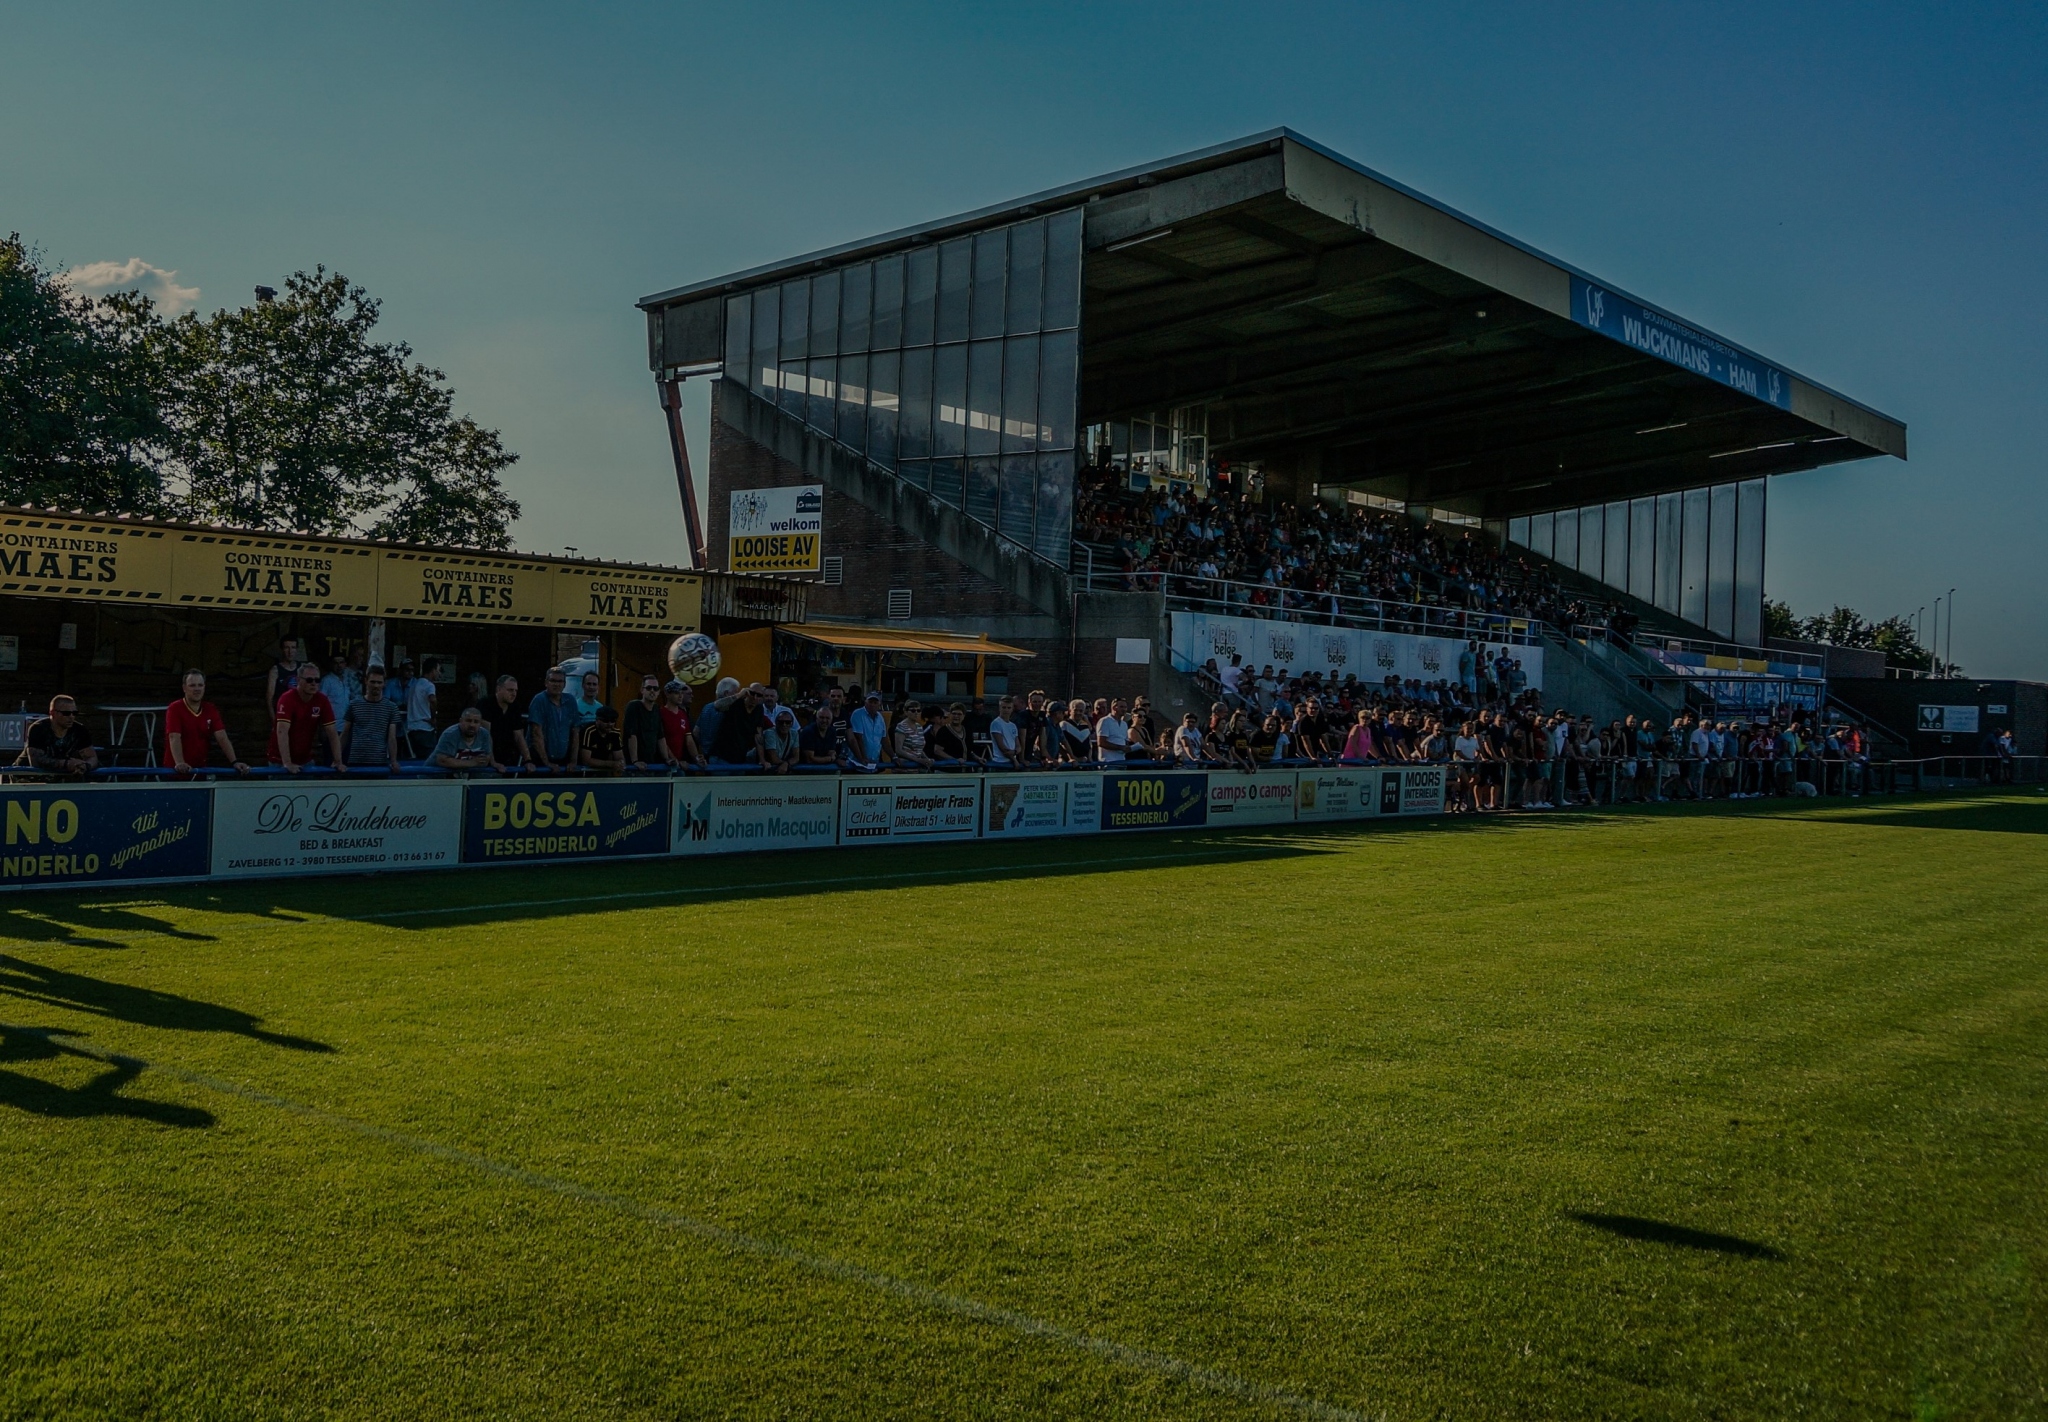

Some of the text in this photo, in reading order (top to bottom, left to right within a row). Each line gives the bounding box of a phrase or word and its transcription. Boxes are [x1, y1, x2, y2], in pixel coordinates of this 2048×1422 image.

[1622, 314, 1711, 374] WIJCKMANS
[1729, 362, 1757, 396] HAM
[770, 518, 820, 531] welkom
[0, 533, 118, 554] ONTAINERS
[735, 535, 814, 557] LOOISE AV
[0, 549, 117, 583] MAES
[225, 552, 332, 571] CONTAINERS
[224, 567, 331, 597] MAES
[422, 568, 514, 585] CONTAINERS
[422, 581, 513, 609] MAES
[590, 582, 669, 597] CONTAINERS
[589, 594, 667, 619] MAES
[1214, 635, 1236, 659] belge
[1273, 641, 1294, 663] belge
[1327, 647, 1346, 666] belge
[1377, 651, 1395, 670] belge
[1423, 655, 1440, 673] belge
[1405, 771, 1441, 788] MOORS
[717, 796, 782, 807] Interieurinrichting
[788, 795, 832, 805] Maatkeukens
[895, 794, 974, 811] Herbergier Frans
[1117, 780, 1165, 807] TORO
[1211, 786, 1246, 803] camps
[1259, 785, 1292, 802] camps
[253, 793, 427, 834] De Lindehoeve
[484, 791, 601, 830] BOSSA
[620, 801, 638, 820] Uit
[850, 811, 887, 824] Cliché
[929, 815, 938, 826] 51
[1111, 811, 1169, 826] TESSENDERLO
[5, 799, 79, 845] NO
[131, 811, 159, 834] Uit
[605, 807, 659, 848] sympathie!
[715, 815, 831, 840] Johan Macquoi
[110, 819, 192, 870] sympathie!
[300, 837, 384, 850] BED & BREAKFAST
[483, 835, 597, 856] TESSENDERLO
[0, 853, 99, 878] NDERLO
[228, 858, 281, 868] ZAVELBERG
[284, 857, 295, 866] 12
[302, 856, 325, 866] 3980
[326, 853, 386, 865] TESSENDERLO
[393, 852, 409, 862] 013
[410, 852, 421, 861] 66
[423, 851, 433, 861] 31
[435, 851, 445, 860] 67
